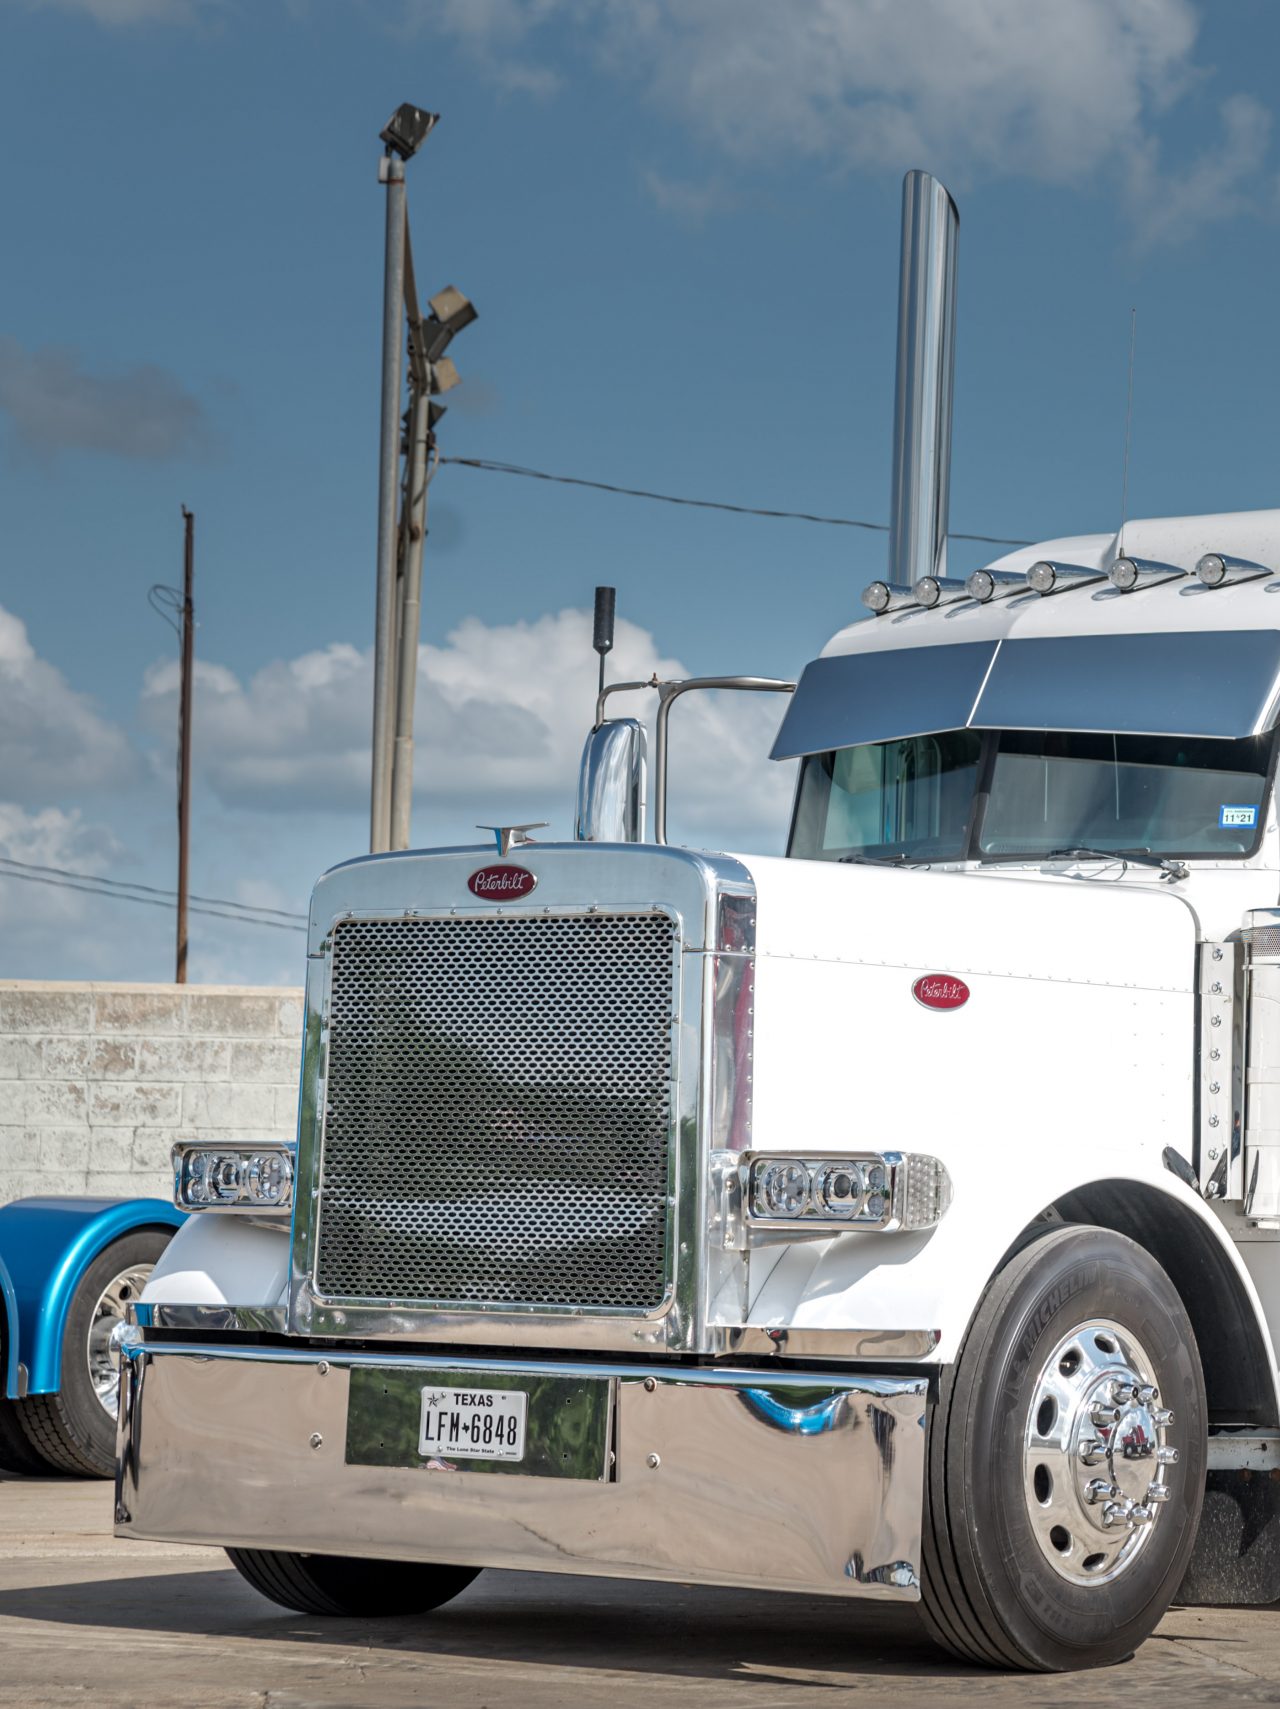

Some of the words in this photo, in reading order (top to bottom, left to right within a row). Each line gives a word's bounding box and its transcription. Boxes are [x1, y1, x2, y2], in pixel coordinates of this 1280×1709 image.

[1240, 814, 1252, 823] 21
[475, 871, 529, 893] Peterbilt
[920, 978, 966, 999] Peterbilt
[1023, 1266, 1098, 1357] MICHELIN
[453, 1393, 494, 1408] TEXAS
